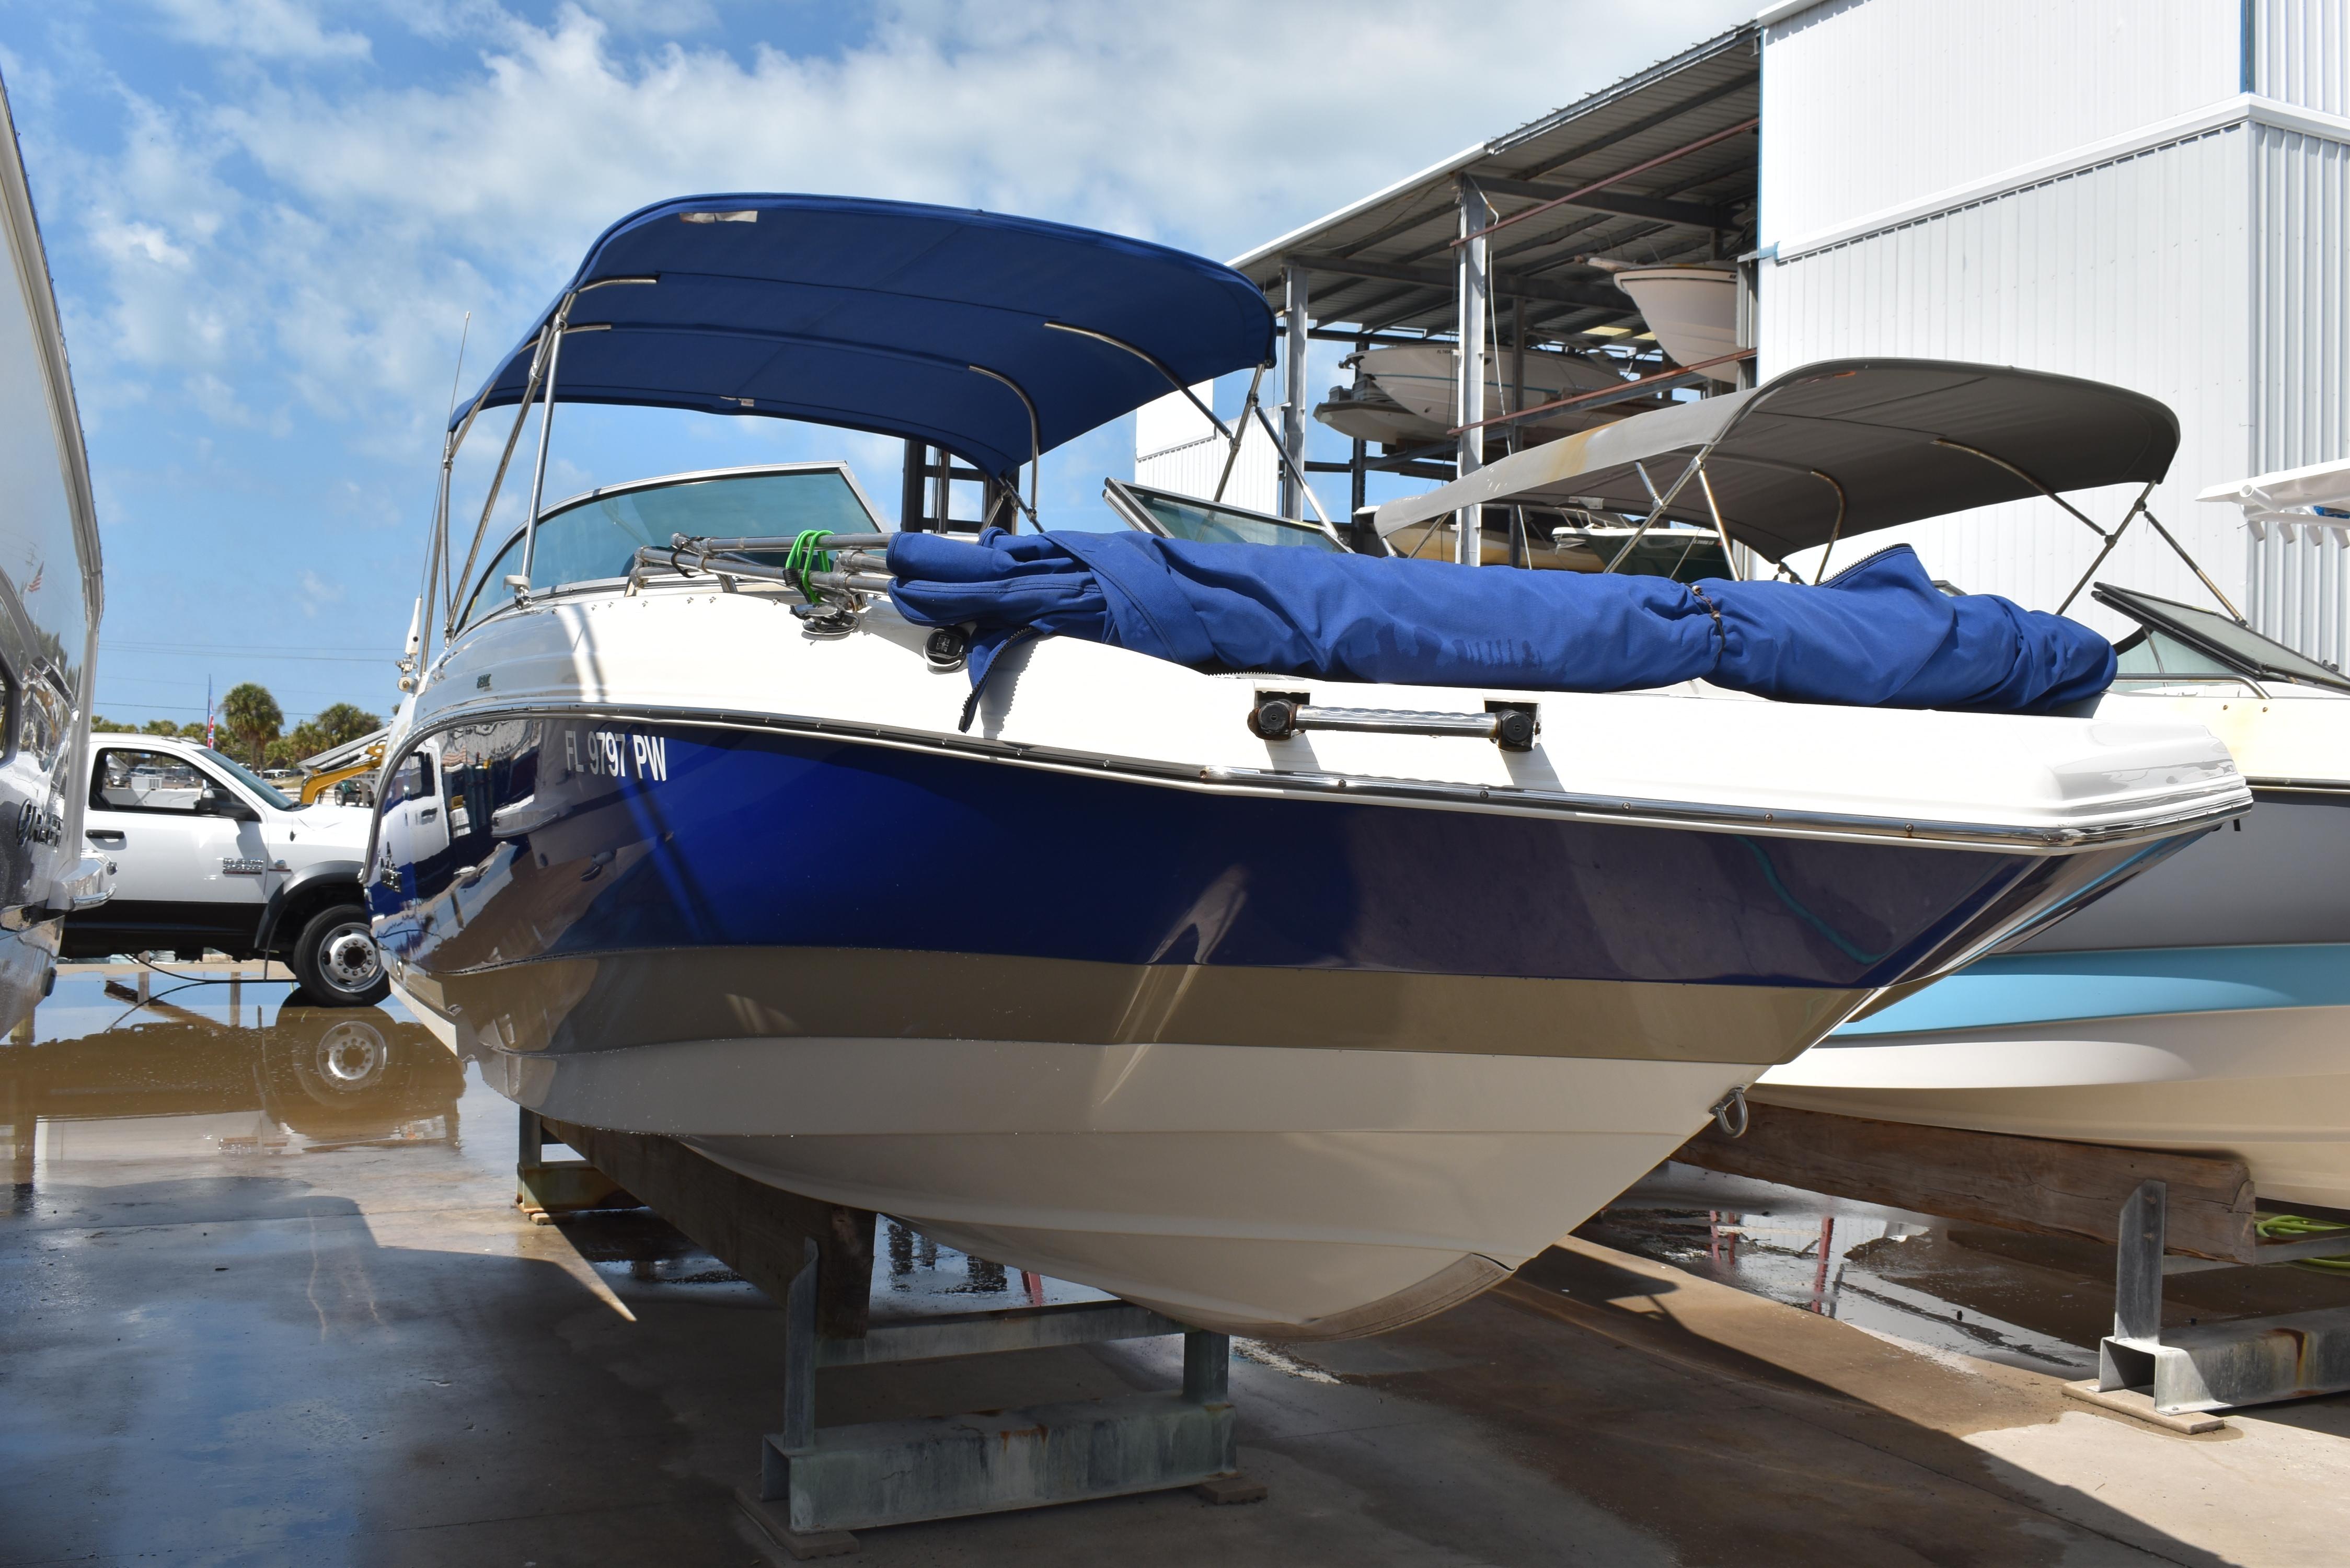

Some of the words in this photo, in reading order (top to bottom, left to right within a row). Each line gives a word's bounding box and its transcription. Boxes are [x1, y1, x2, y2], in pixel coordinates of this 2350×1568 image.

[565, 730, 584, 773] FL
[588, 731, 626, 777] 9797
[632, 734, 666, 781] PW
